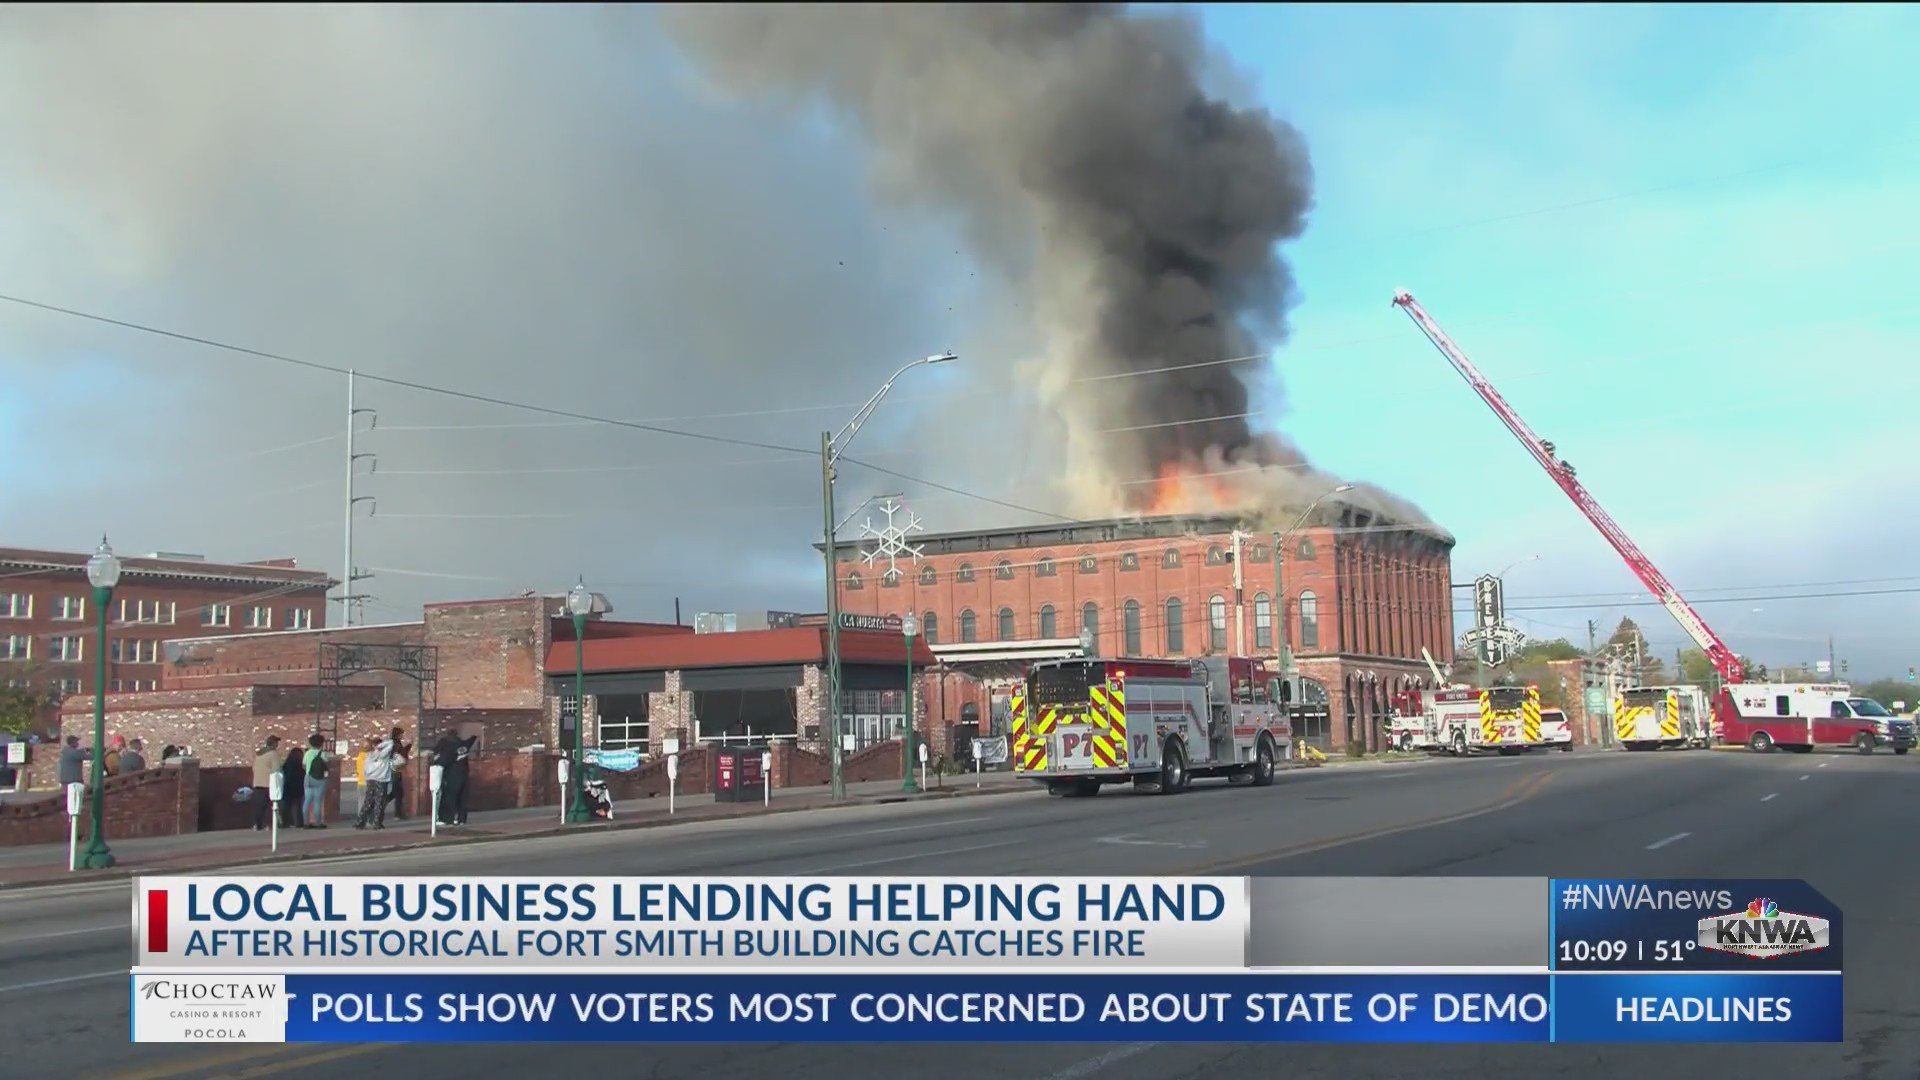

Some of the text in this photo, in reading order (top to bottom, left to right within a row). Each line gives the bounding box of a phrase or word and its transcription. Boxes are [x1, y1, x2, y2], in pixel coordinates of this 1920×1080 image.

[844, 614, 855, 627] LA
[1471, 727, 1480, 740] P2
[1500, 725, 1516, 738] P2
[1062, 732, 1093, 758] P7
[1133, 734, 1149, 759] P7
